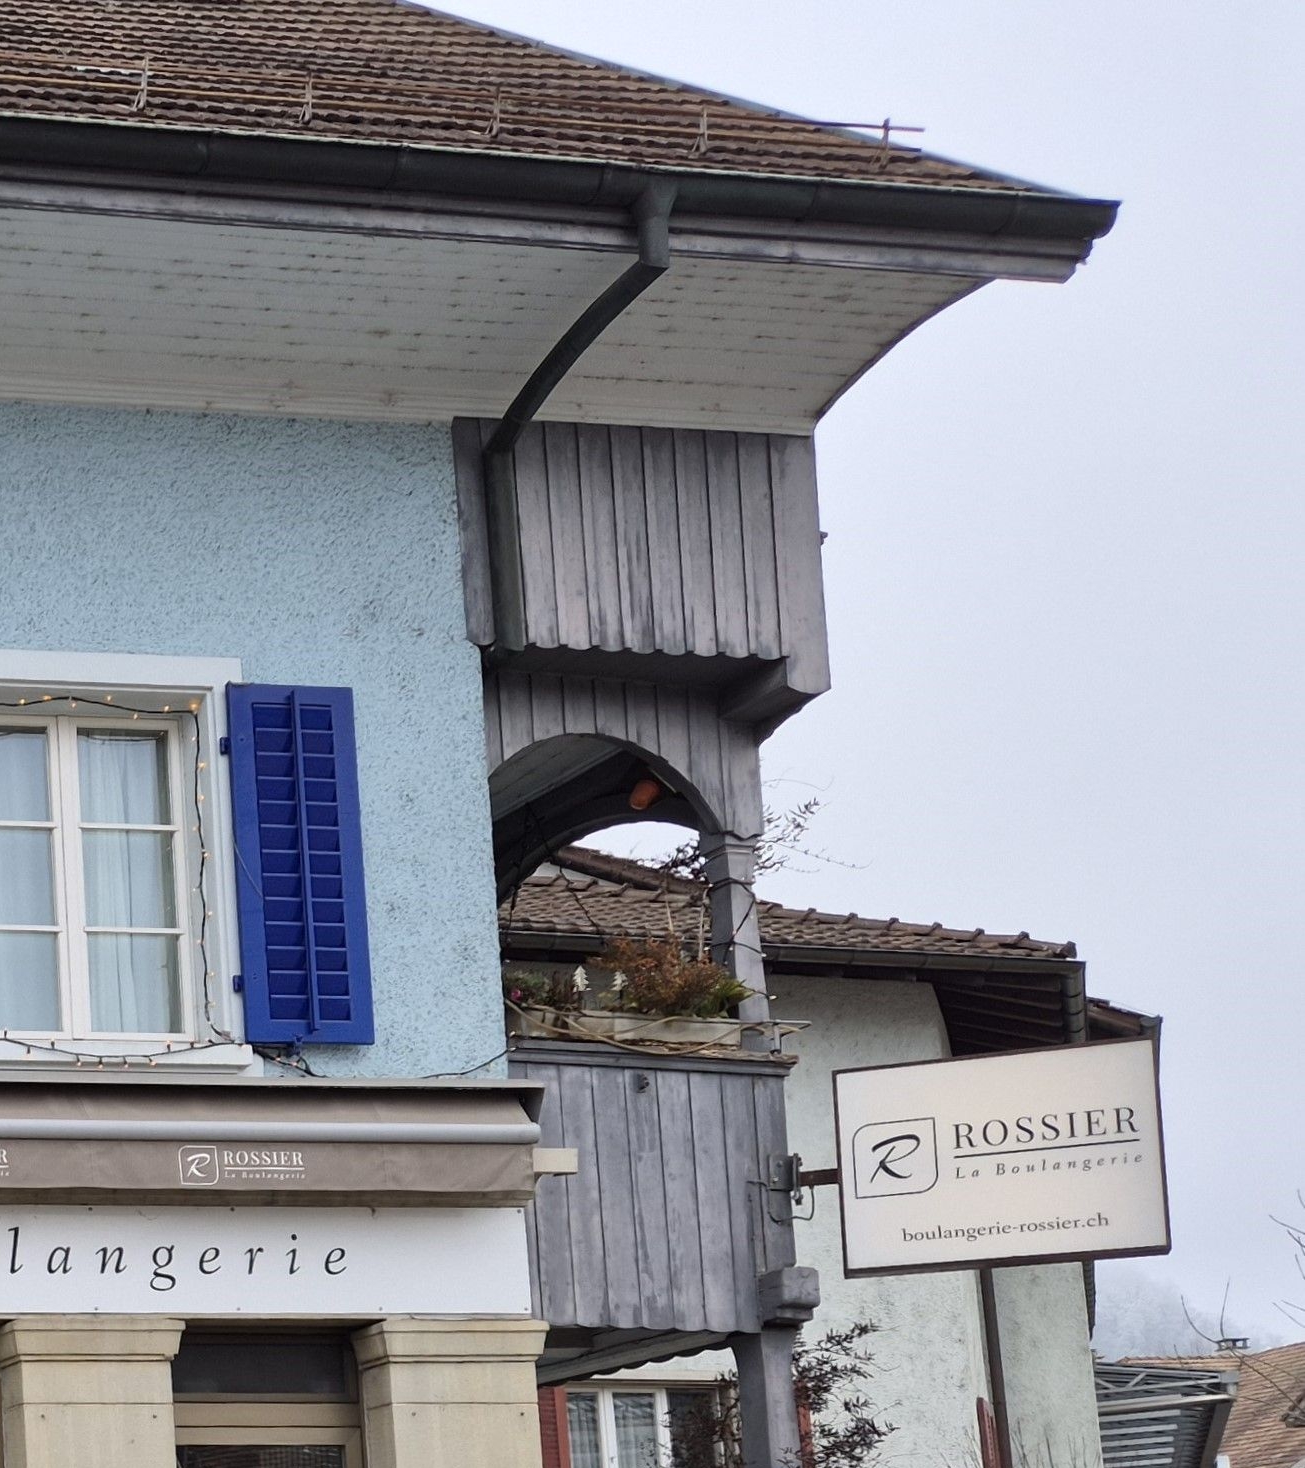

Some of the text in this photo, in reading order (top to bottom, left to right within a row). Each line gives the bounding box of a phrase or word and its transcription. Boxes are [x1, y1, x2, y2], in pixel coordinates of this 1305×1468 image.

[952, 1106, 1140, 1151] ROSSIER
[187, 1153, 211, 1177] R
[223, 1150, 304, 1166] ROSSIER
[870, 1133, 920, 1183] R
[955, 1151, 1142, 1179] La Boulangerie
[242, 1171, 306, 1181] Boulangerie
[902, 1212, 1109, 1243] boulangerie-rossier.ch
